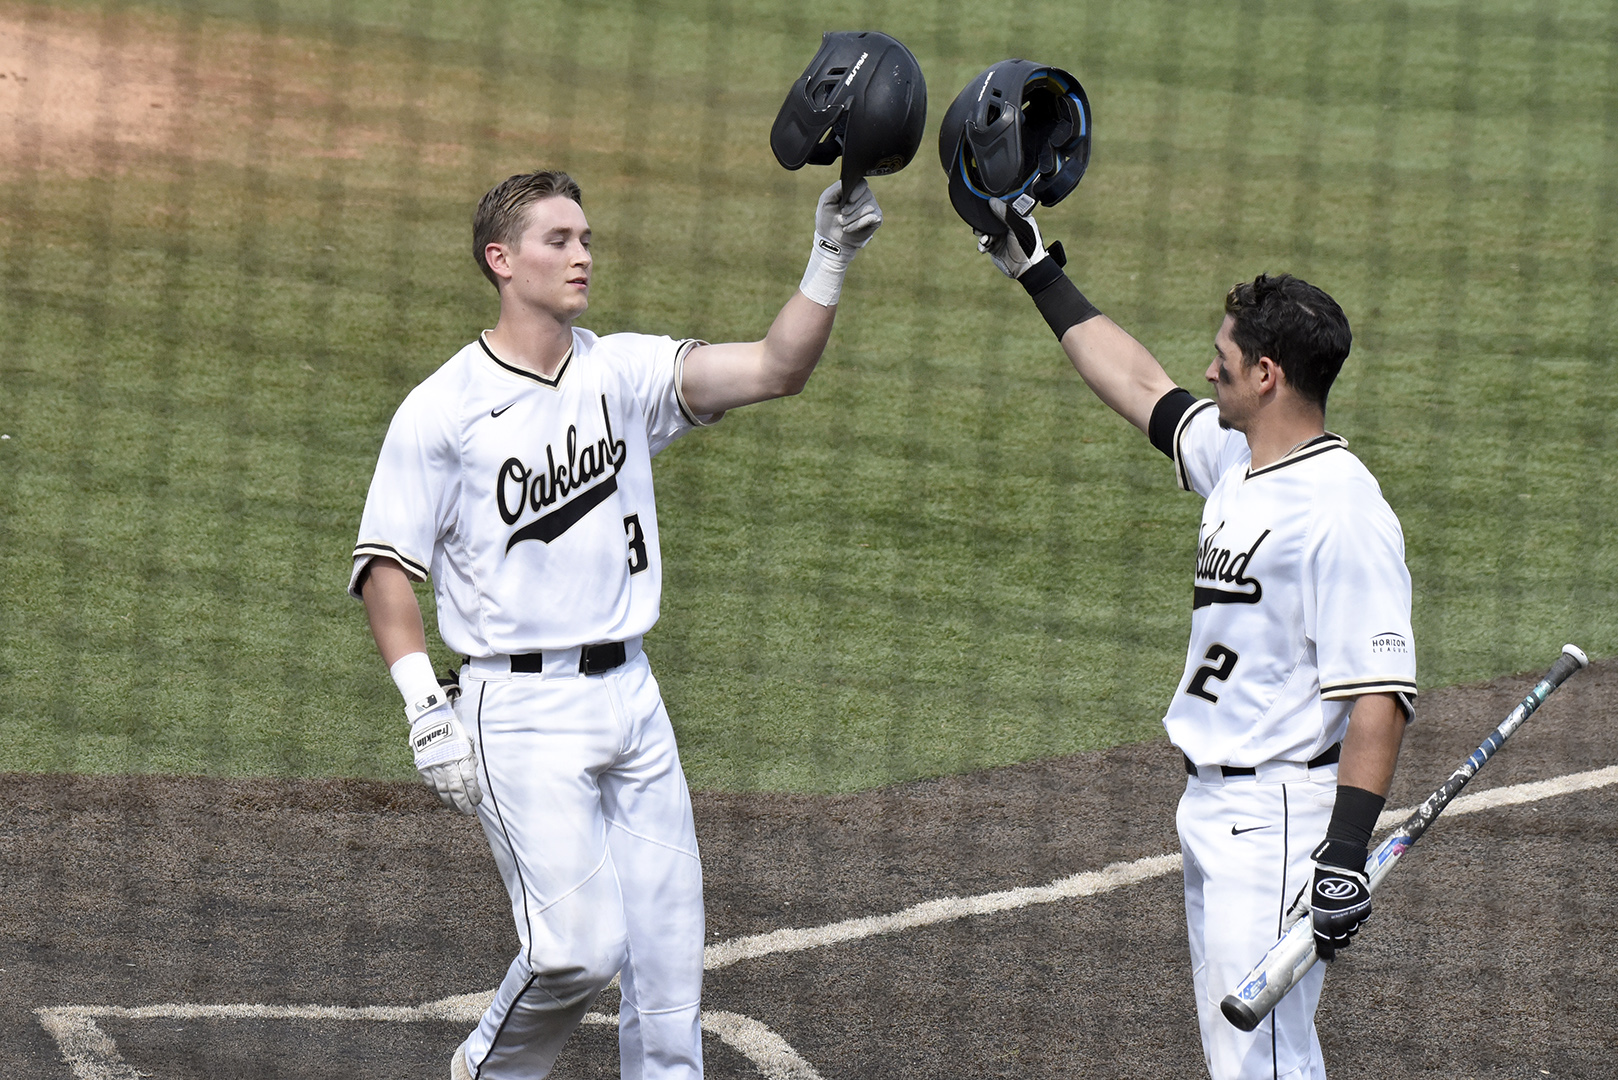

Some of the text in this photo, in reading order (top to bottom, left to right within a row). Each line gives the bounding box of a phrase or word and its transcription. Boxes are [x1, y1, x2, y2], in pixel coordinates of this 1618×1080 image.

[623, 513, 648, 576] 3
[1186, 642, 1239, 704] 2
[1372, 639, 1405, 647] HORIZON
